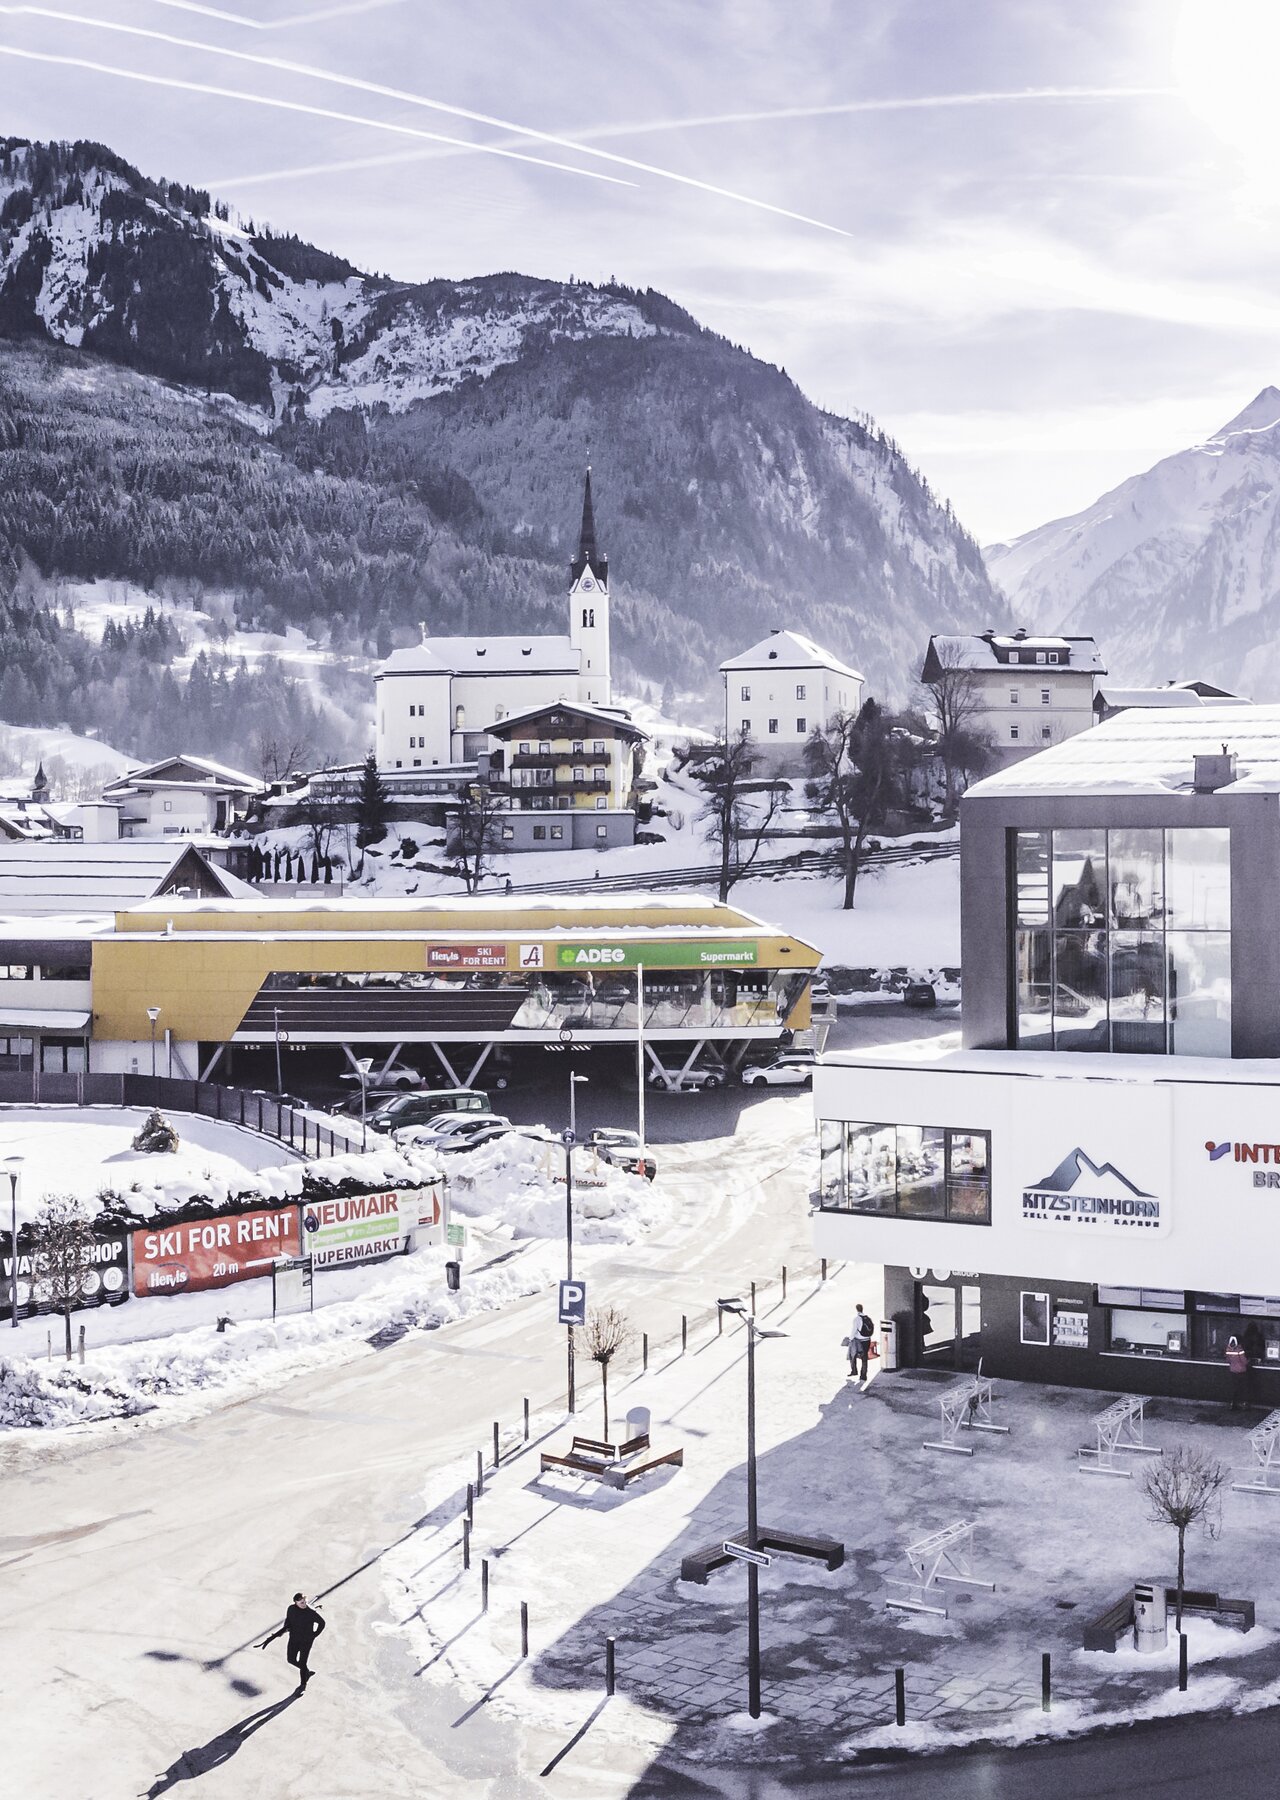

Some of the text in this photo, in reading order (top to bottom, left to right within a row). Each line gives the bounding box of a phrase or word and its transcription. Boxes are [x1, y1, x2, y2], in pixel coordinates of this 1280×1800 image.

[431, 951, 459, 962] Hervis
[463, 956, 505, 965] FOR RENT
[477, 947, 492, 956] SKI
[575, 948, 754, 963] ADEG Supermarkt
[307, 1192, 399, 1226] NEUMAIR
[1022, 1192, 1160, 1218] KITZSTEINHORN
[1023, 1211, 1049, 1220] ZELL
[1114, 1218, 1160, 1228] KAPRUN
[144, 1212, 292, 1259] SKI FOR RENT
[80, 1241, 123, 1265] SHOP
[150, 1269, 188, 1288] Hervis
[212, 1261, 239, 1278] 20 m
[562, 1285, 583, 1310] P
